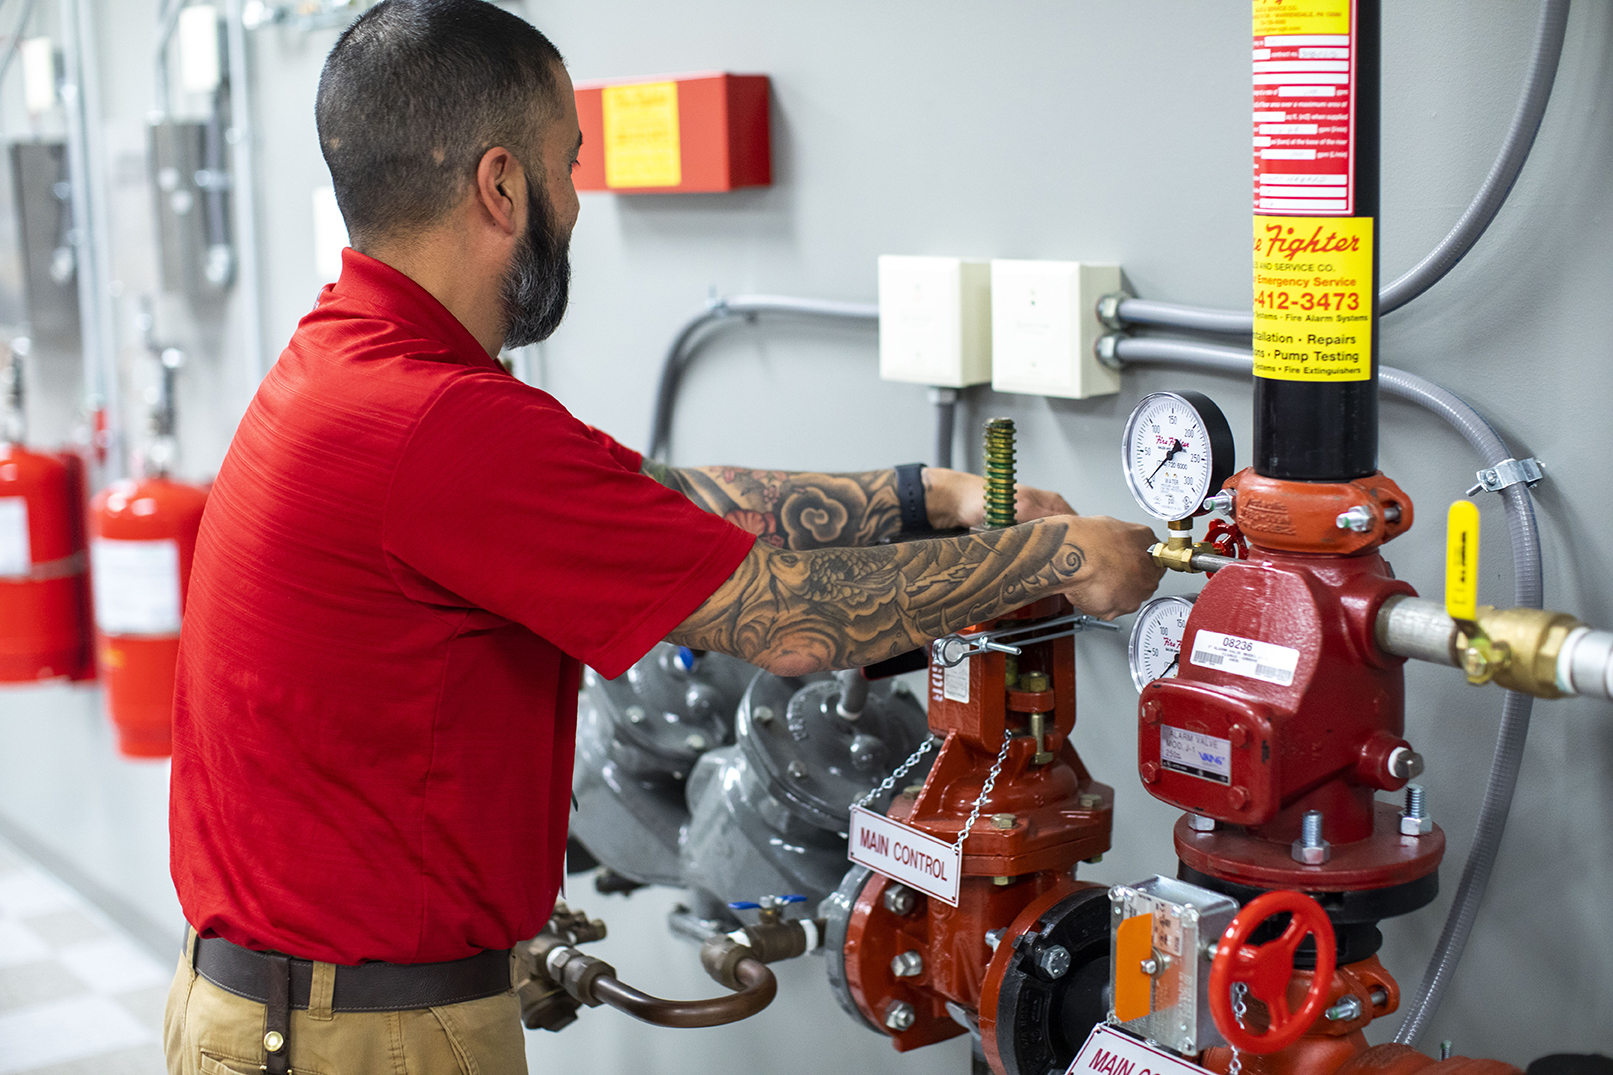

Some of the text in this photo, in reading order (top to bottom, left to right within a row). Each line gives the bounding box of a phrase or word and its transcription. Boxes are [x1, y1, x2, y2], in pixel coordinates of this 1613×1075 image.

[1266, 223, 1360, 261] Fighter
[1274, 262, 1314, 272] SERVICE
[1318, 264, 1336, 272] CO.
[1258, 274, 1310, 288] Emergency
[1312, 276, 1356, 288] Service
[1285, 313, 1302, 322] Fire
[1305, 314, 1333, 322] Alarm
[1336, 314, 1368, 324] Systems
[1307, 334, 1357, 346] Repairs
[1274, 349, 1309, 363] Pump
[1314, 351, 1360, 364] Testing
[1284, 366, 1300, 374] Fire
[1303, 366, 1361, 376] Extinguishers
[1168, 415, 1177, 424] 150
[1152, 424, 1160, 434] 100
[1184, 428, 1194, 438] 200
[1144, 446, 1151, 456] 50
[1190, 453, 1200, 464] 250
[1184, 476, 1193, 486] 300
[1176, 618, 1186, 628] 150
[1160, 626, 1168, 636] 100
[1222, 637, 1254, 652] 08236
[1152, 648, 1159, 657] 50
[1170, 730, 1218, 750] ALARM VALVE
[860, 827, 948, 882] MAIN CONTROL
[1088, 1047, 1136, 1075] MAIN
